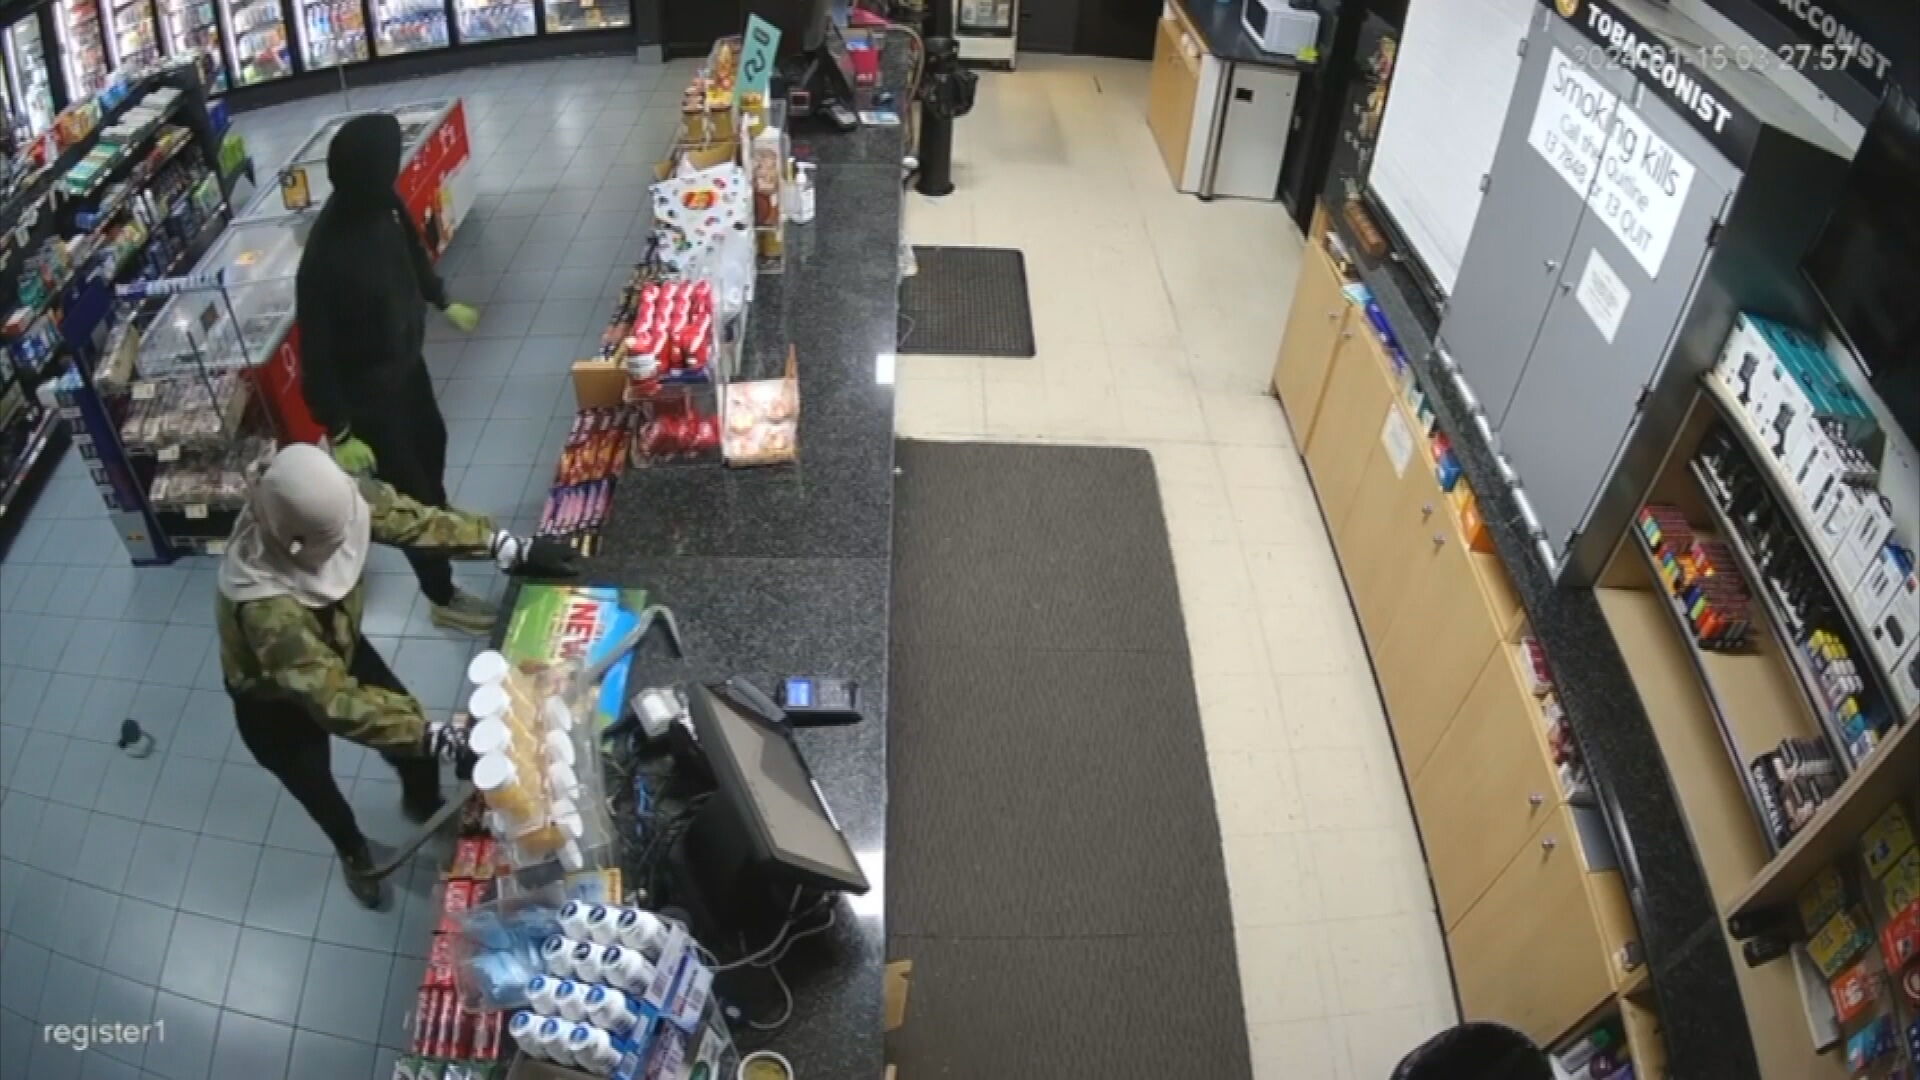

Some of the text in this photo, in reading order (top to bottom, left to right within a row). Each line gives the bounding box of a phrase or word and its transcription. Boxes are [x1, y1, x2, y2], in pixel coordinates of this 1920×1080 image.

[1588, 2, 1733, 133] TOBACCONIST
[1552, 61, 1681, 197] Smokng kills
[1559, 113, 1582, 146] Call
[1605, 192, 1622, 218] 13
[1619, 209, 1655, 252] QUIT
